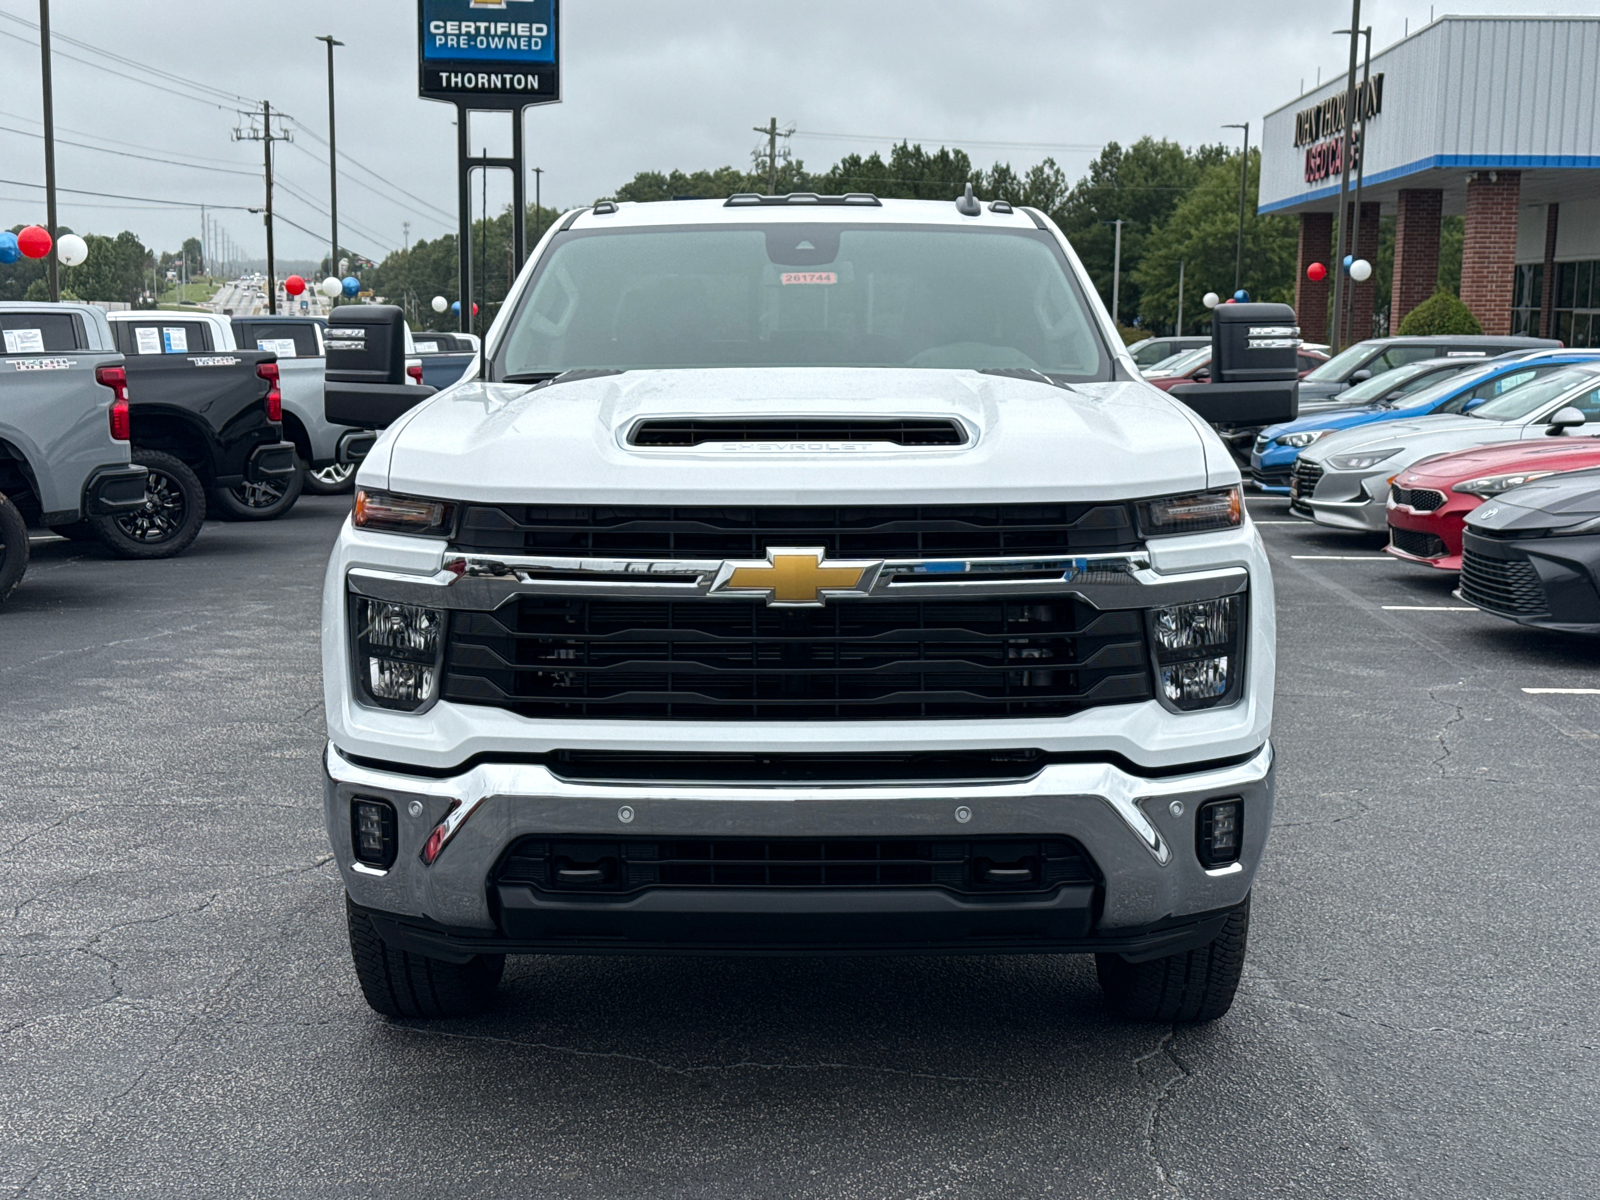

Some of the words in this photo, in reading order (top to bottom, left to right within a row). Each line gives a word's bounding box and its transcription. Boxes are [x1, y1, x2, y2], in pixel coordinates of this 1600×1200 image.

[429, 20, 548, 36] CERTIFIED
[435, 35, 542, 50] PRE-OWNED
[439, 72, 539, 90] THORNTON
[1294, 103, 1320, 147] JOHN
[1304, 141, 1328, 182] USED
[785, 274, 832, 282] 261744
[721, 443, 873, 451] CHEVROLET
